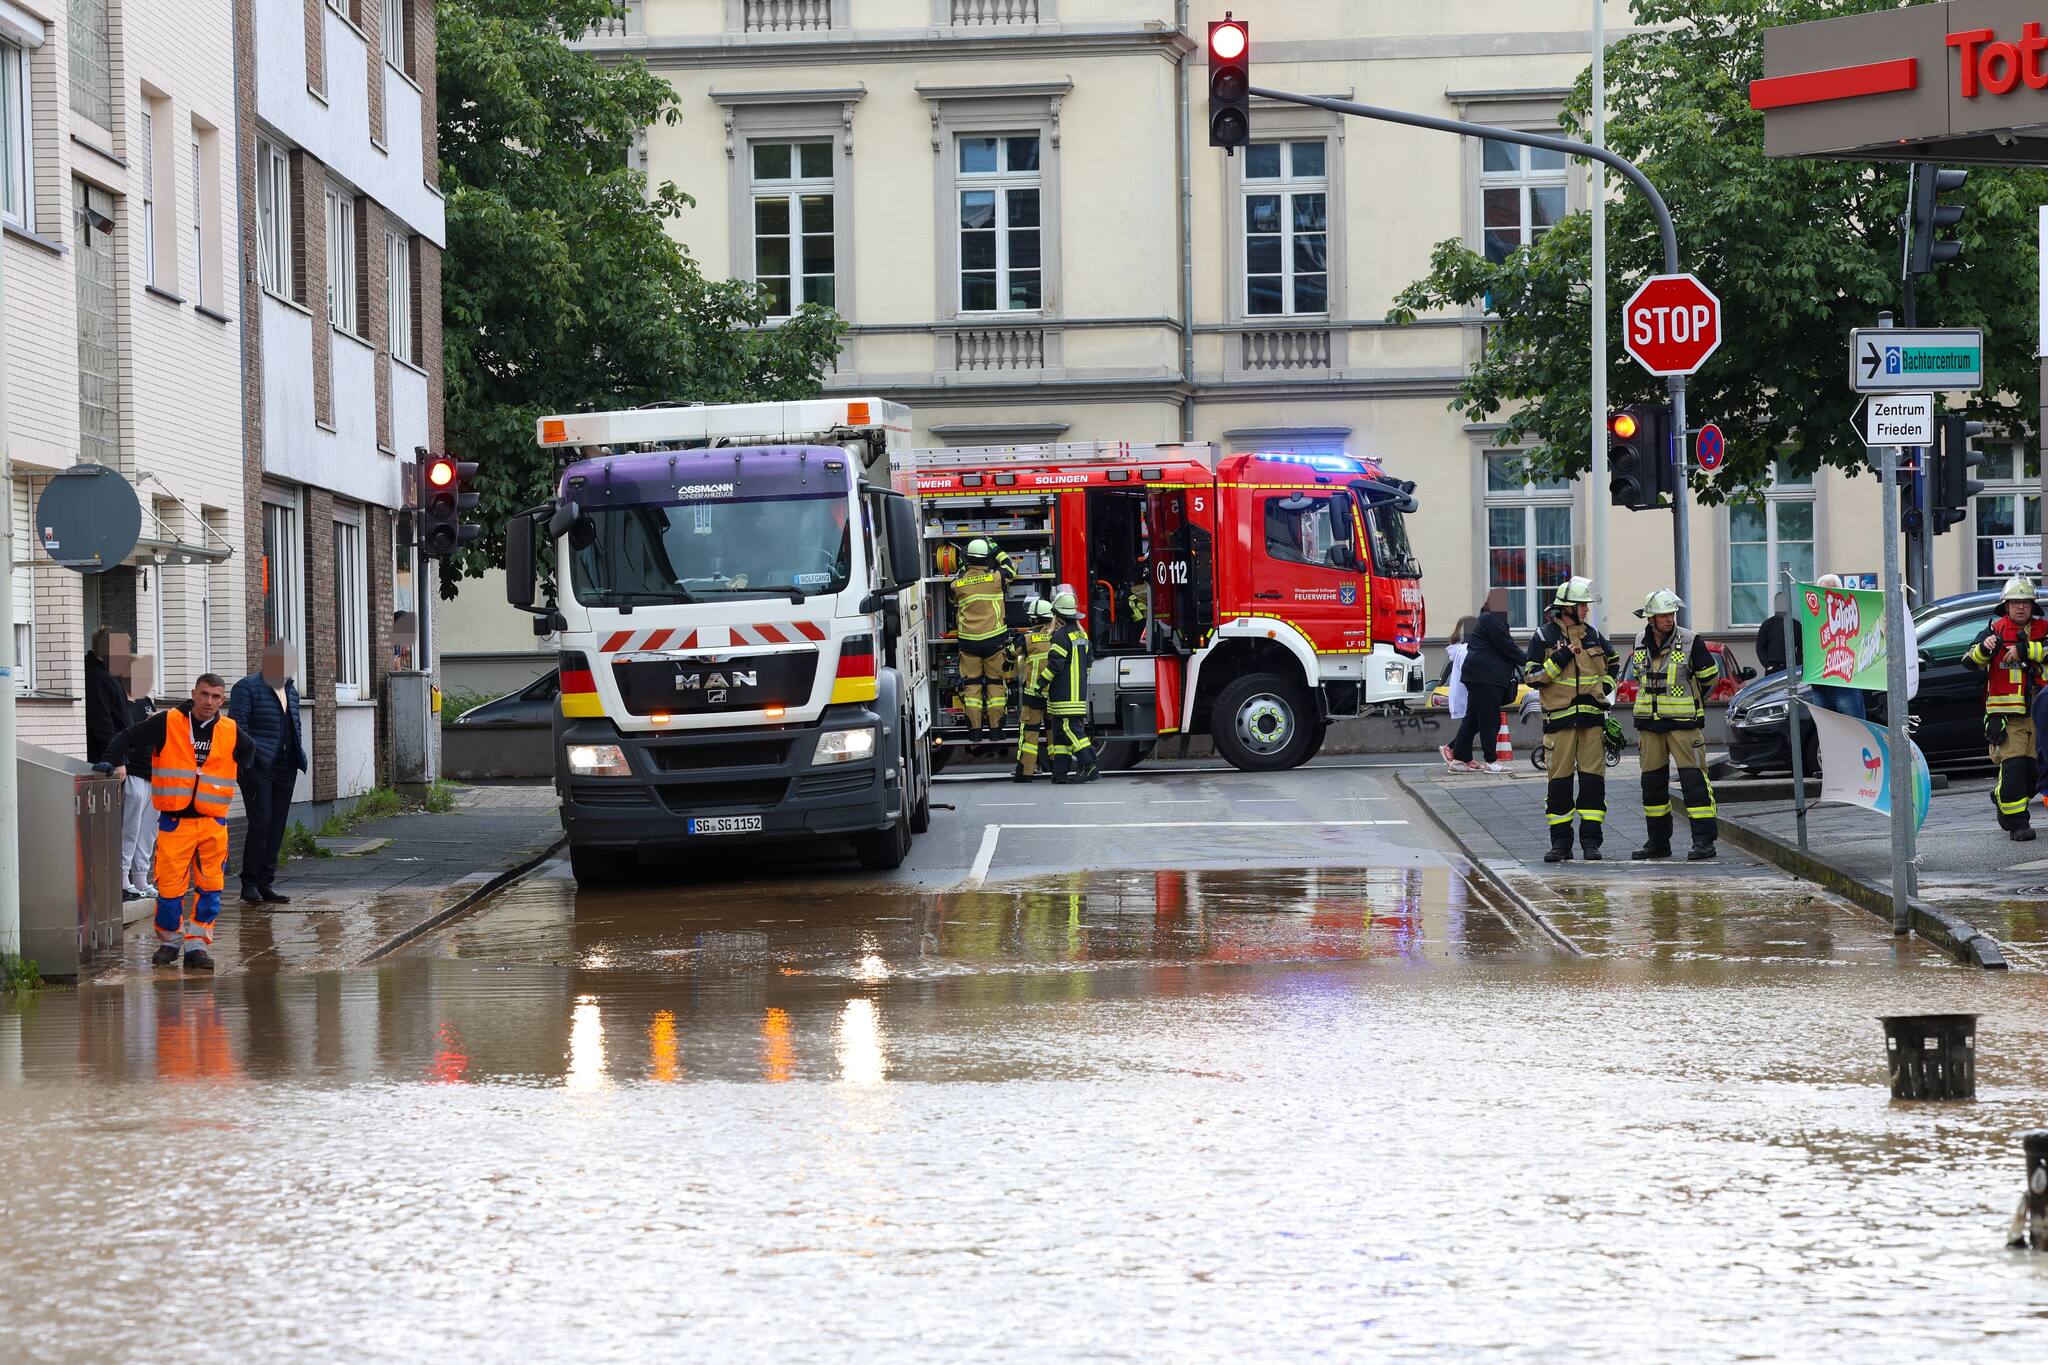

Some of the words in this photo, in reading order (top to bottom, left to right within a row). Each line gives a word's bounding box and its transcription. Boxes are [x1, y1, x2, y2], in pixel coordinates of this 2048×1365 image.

[1634, 305, 1710, 345] STOP
[1902, 350, 1971, 370] Bachtorcentrum
[1875, 403, 1925, 416] Zentrum
[1877, 423, 1922, 436] Frieden
[1035, 475, 1088, 484] SOLINGEN
[678, 483, 733, 494] ASSMANN
[1194, 497, 1204, 511] 5
[800, 573, 830, 584] WOLFGANG
[1169, 560, 1188, 584] 112
[675, 670, 758, 690] MAN
[696, 819, 710, 832] SG
[718, 818, 731, 831] SG
[734, 817, 761, 830] 1152
